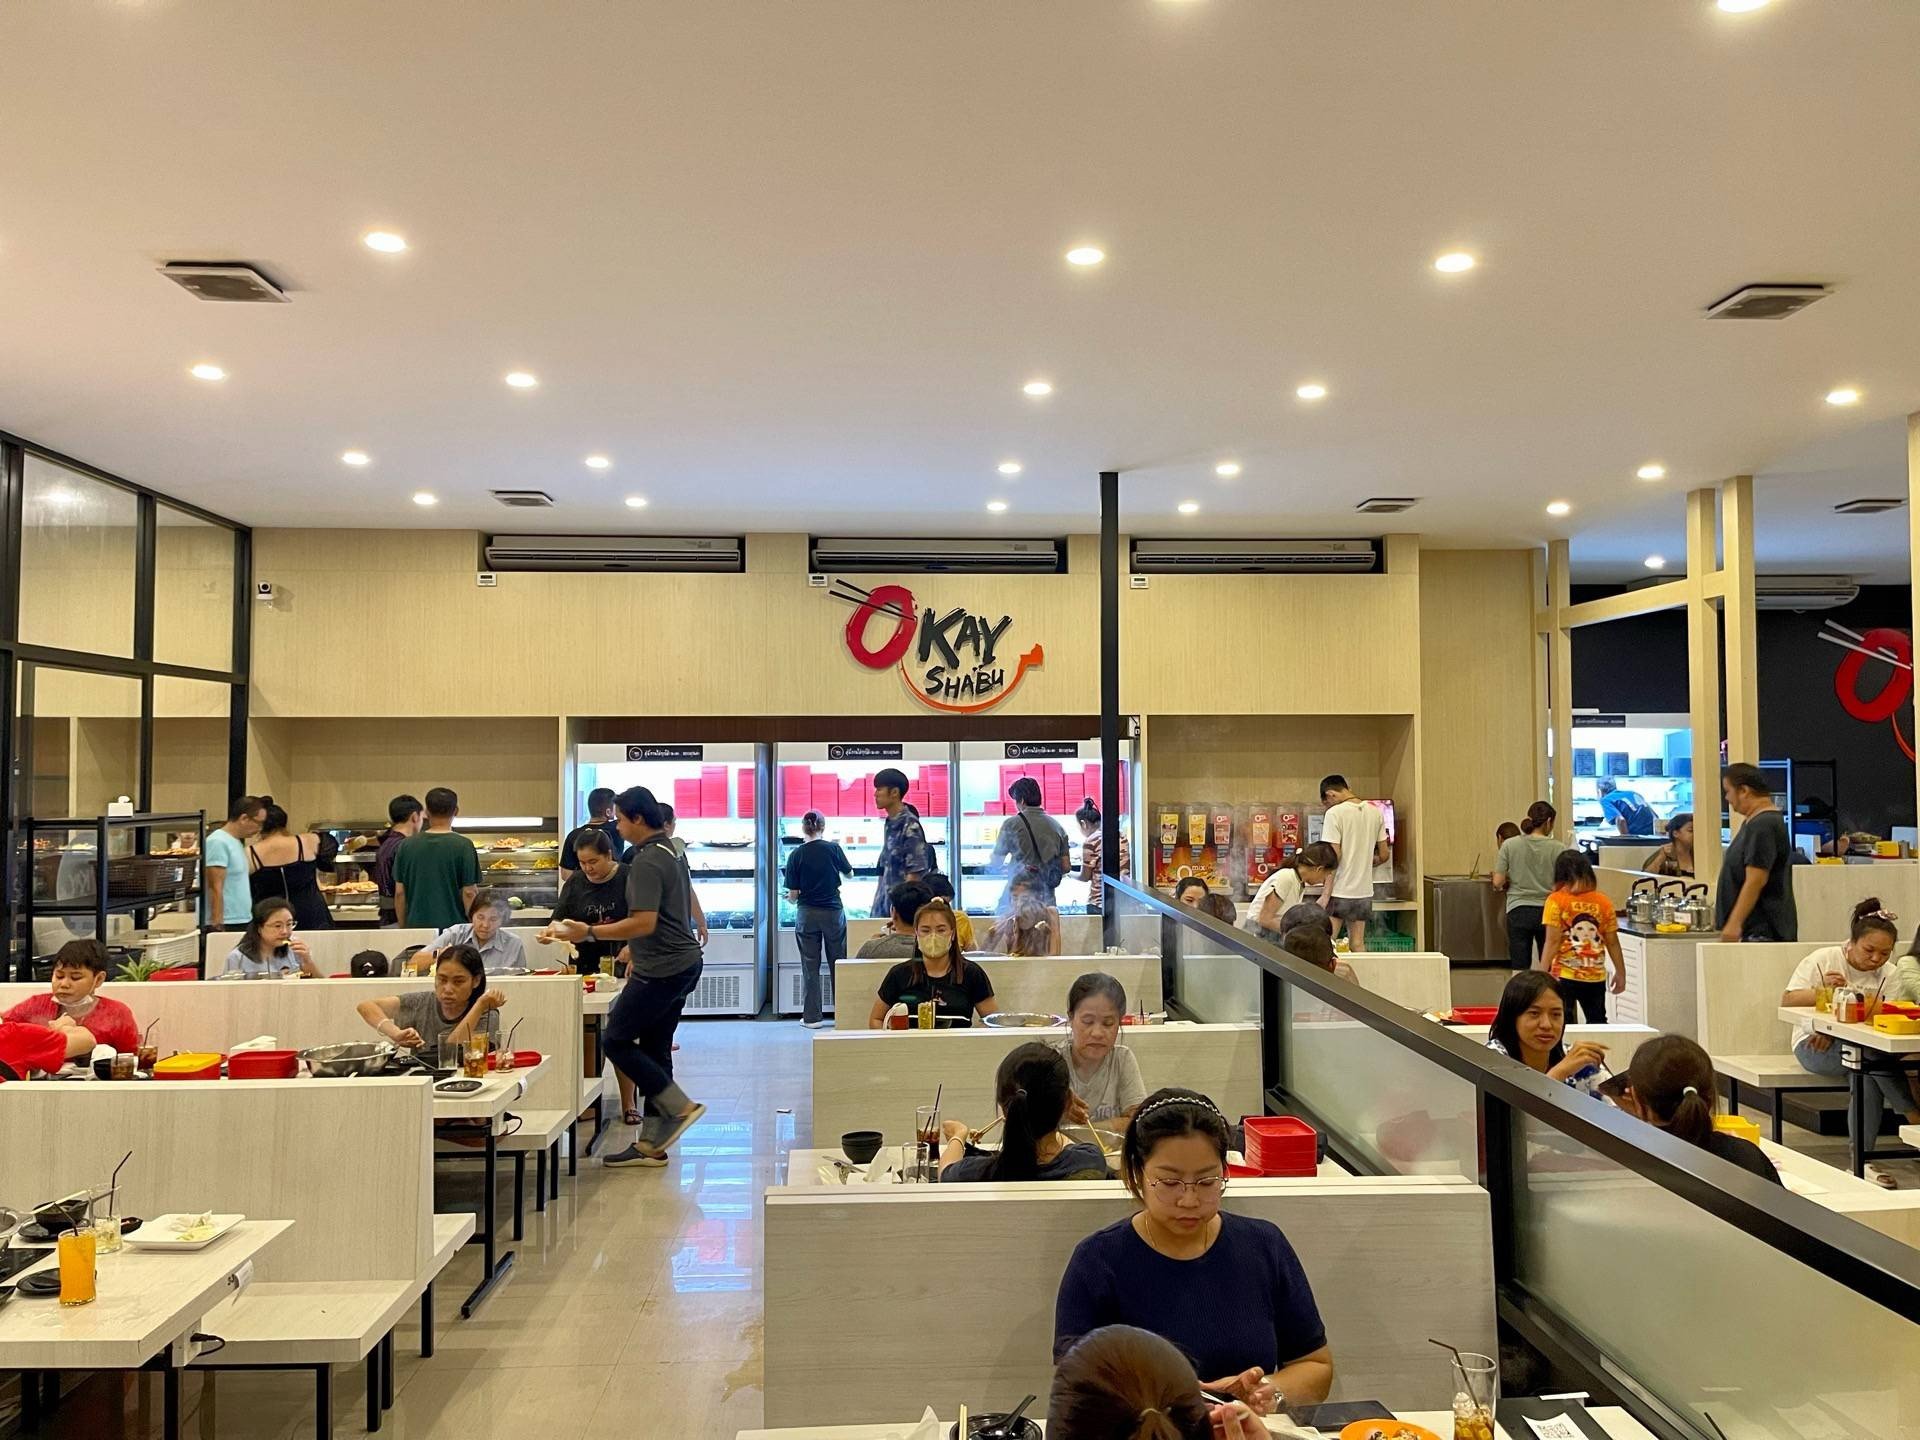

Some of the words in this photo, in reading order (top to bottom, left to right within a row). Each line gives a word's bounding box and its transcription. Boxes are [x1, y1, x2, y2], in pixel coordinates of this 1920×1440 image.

[845, 585, 1013, 670] OKAY
[926, 666, 1005, 699] SHABU
[1574, 903, 1597, 912] 456
